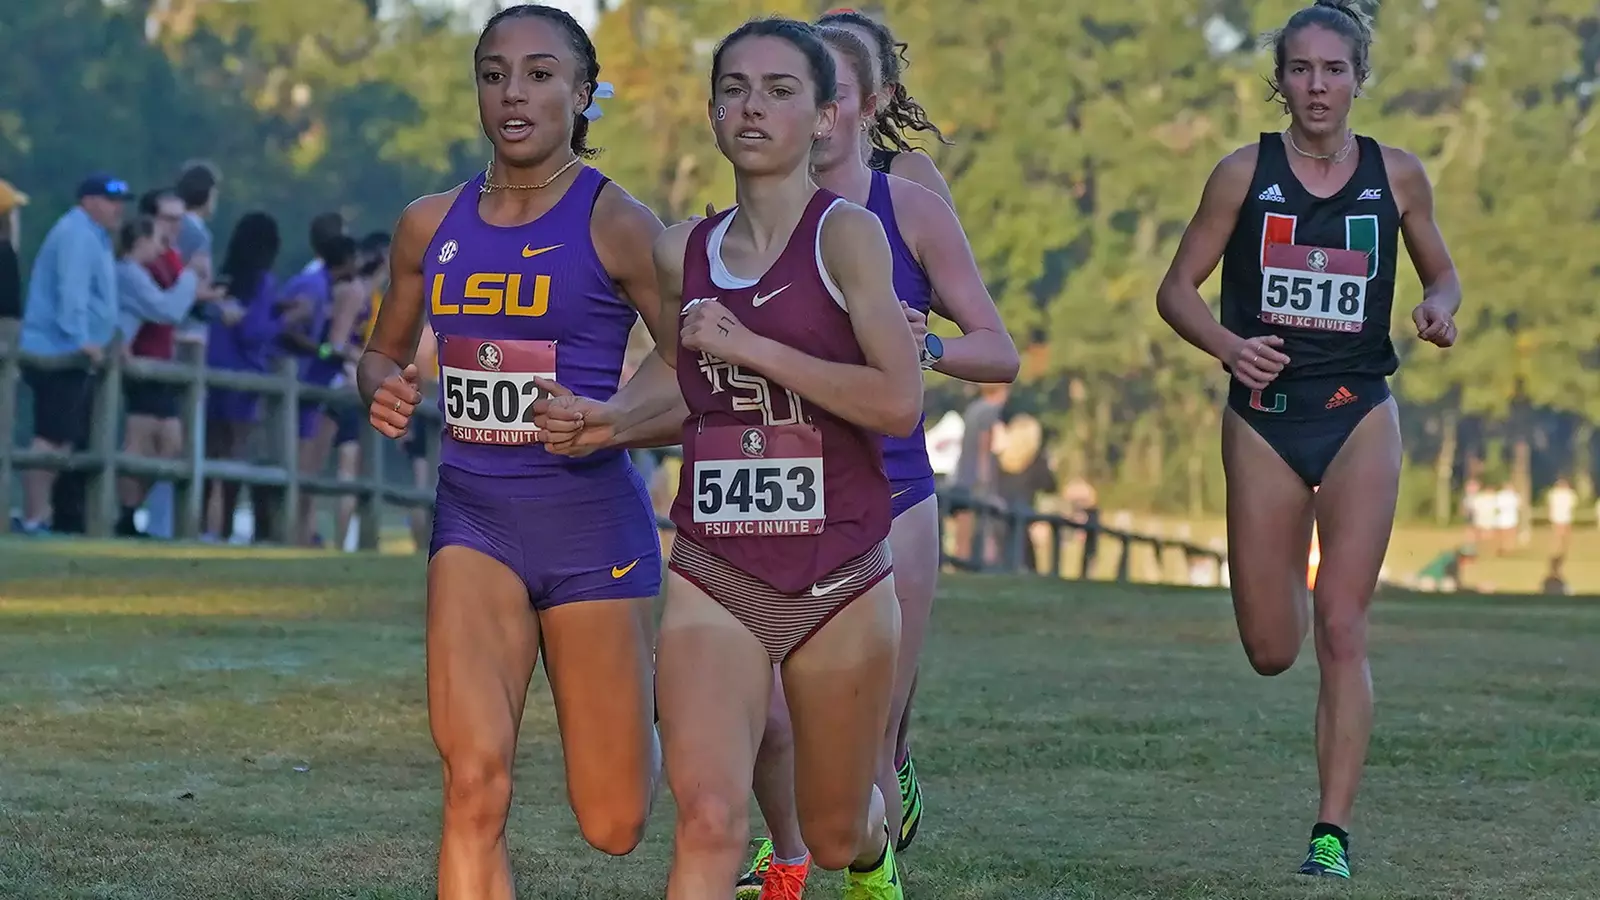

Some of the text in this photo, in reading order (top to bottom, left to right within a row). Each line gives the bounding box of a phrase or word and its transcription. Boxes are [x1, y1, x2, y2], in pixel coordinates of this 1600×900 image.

[1258, 192, 1286, 203] adidas
[1357, 188, 1382, 200] ACC
[431, 273, 551, 317] LSU
[1266, 274, 1360, 316] 5518
[1271, 313, 1352, 331] FSU XC INVITE
[446, 375, 549, 424] 5502
[452, 426, 472, 440] FSU
[475, 430, 492, 442] XC
[698, 466, 816, 515] 5453
[705, 520, 809, 535] FSU XC INVITE
